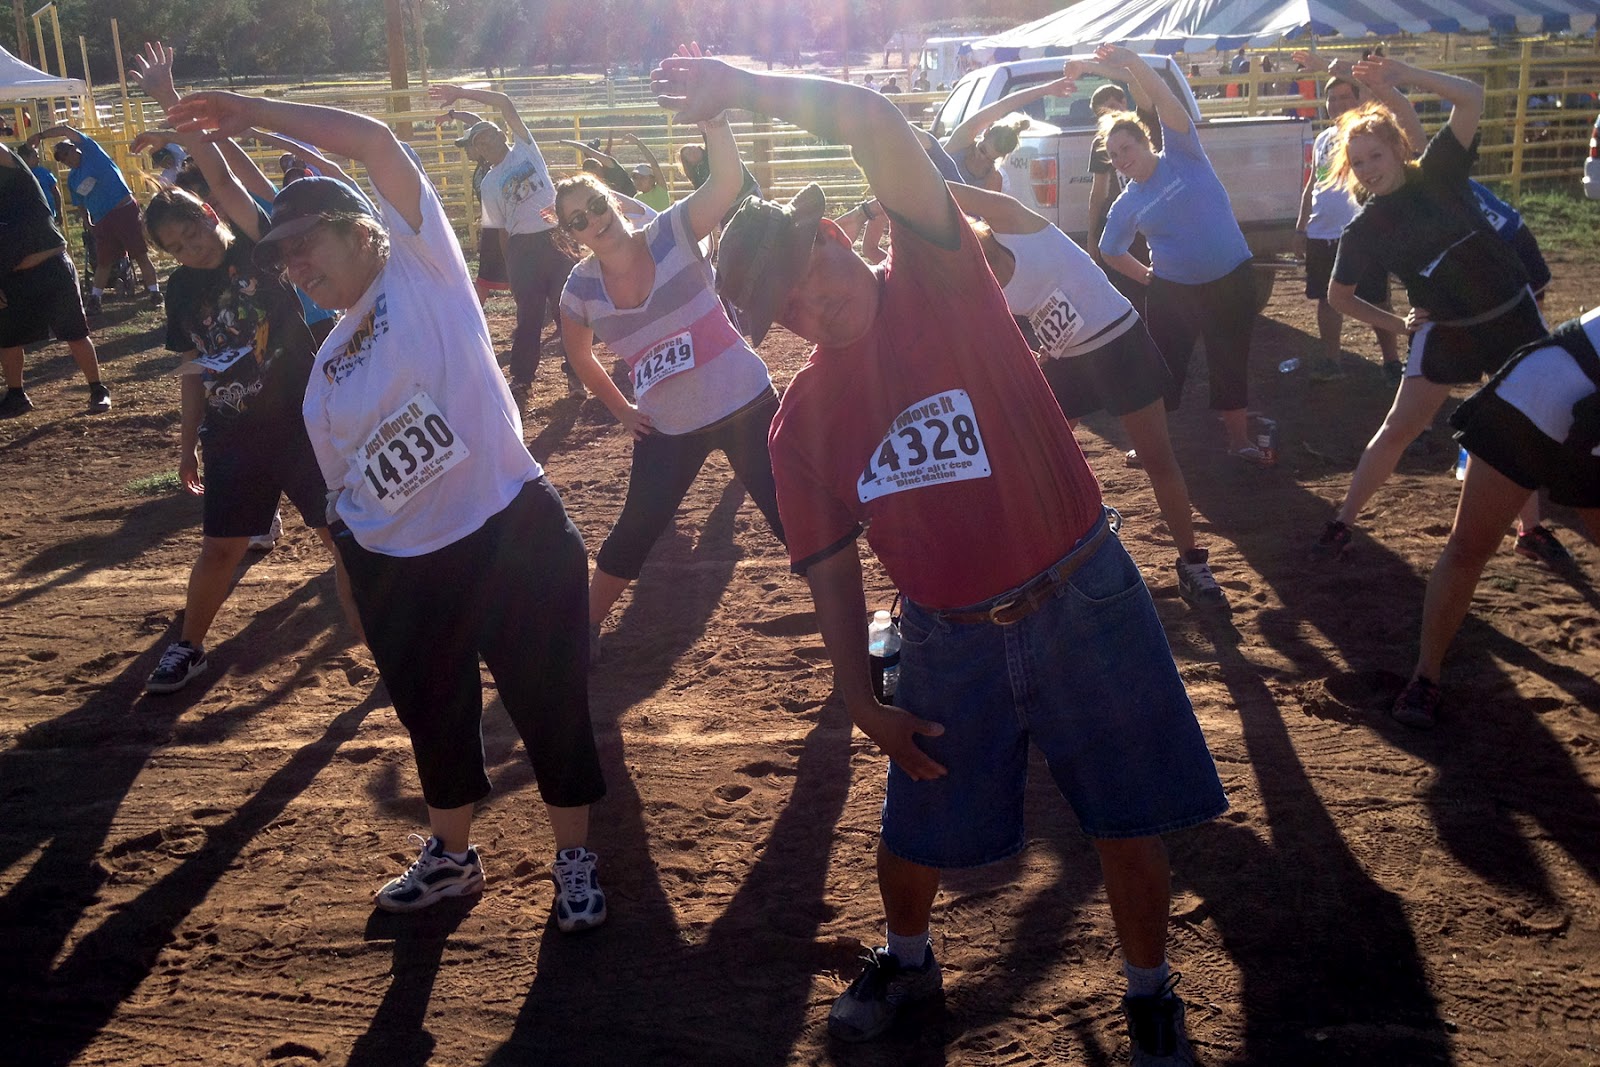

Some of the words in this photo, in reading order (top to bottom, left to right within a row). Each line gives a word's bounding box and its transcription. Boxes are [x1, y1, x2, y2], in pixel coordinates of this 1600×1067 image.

[1037, 301, 1077, 352] 14322
[636, 343, 691, 389] 14249
[364, 433, 385, 460] Just
[379, 412, 413, 443] Move
[407, 402, 423, 420] It
[896, 402, 940, 430] Move
[938, 395, 955, 414] It
[364, 413, 454, 500] 14330
[419, 465, 444, 485] Nation
[921, 471, 957, 482] Nation
